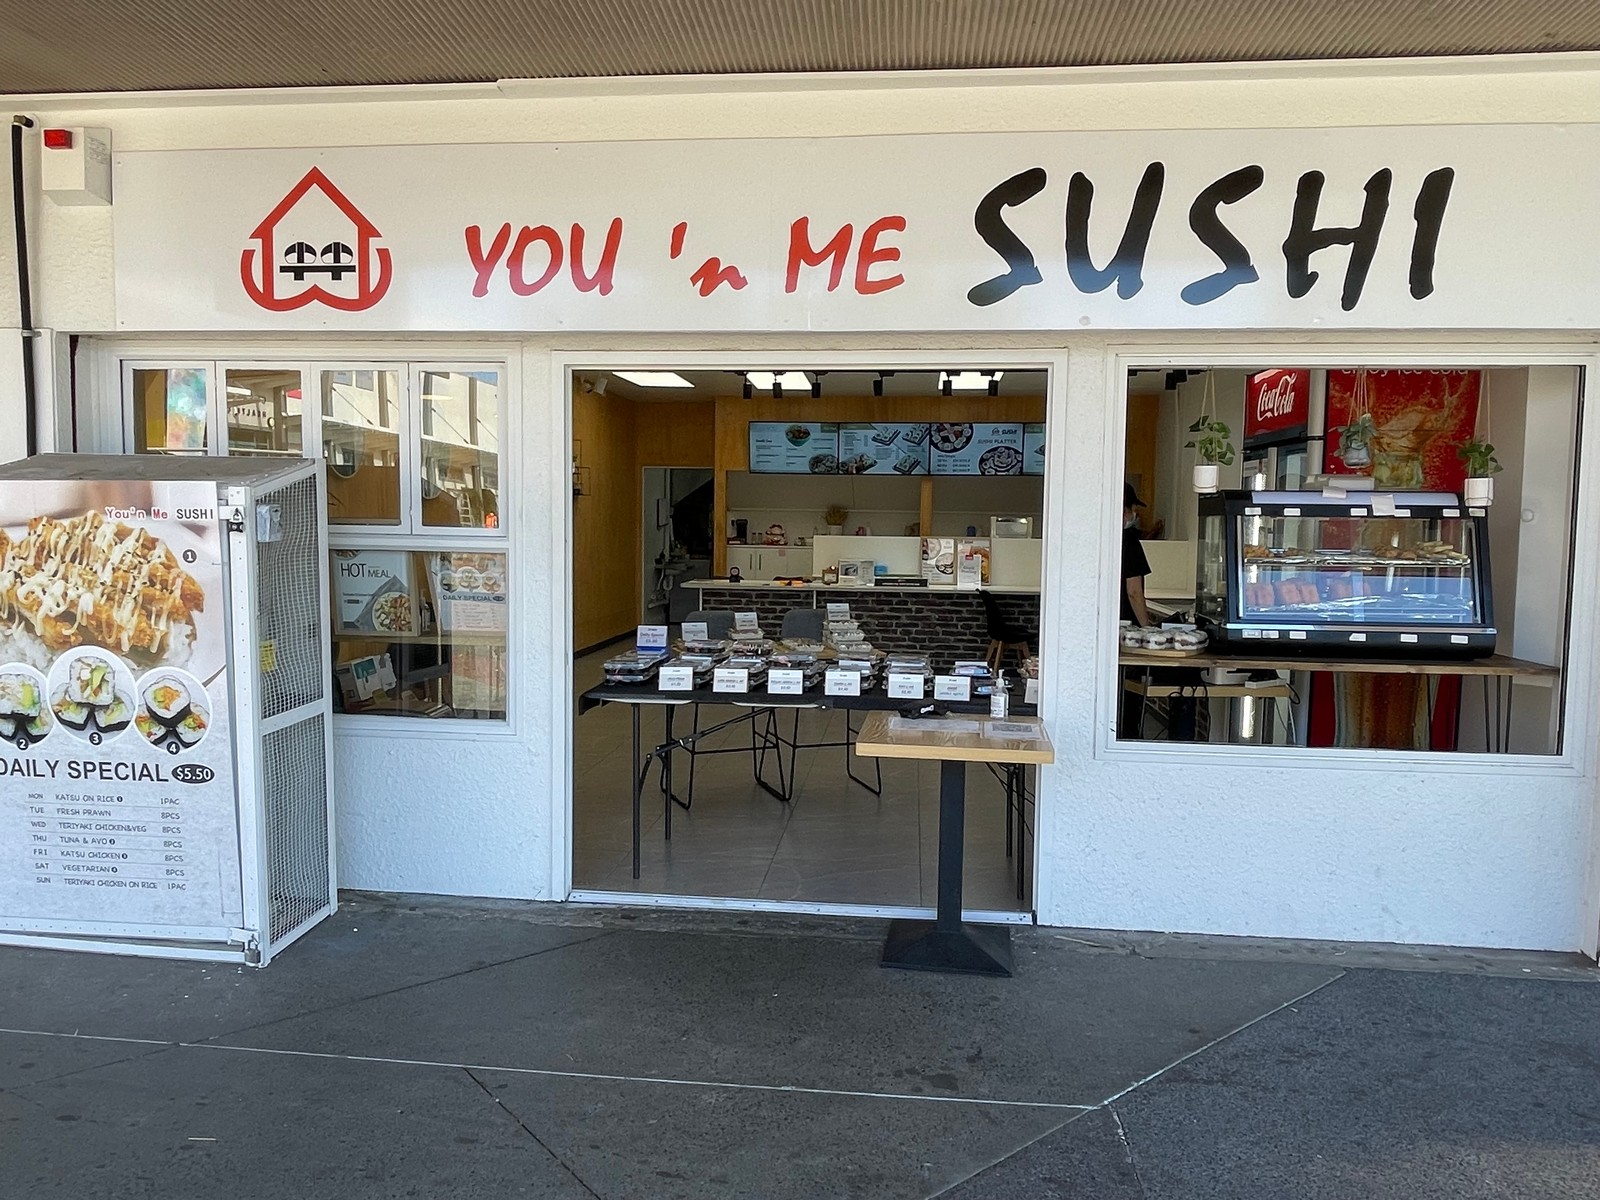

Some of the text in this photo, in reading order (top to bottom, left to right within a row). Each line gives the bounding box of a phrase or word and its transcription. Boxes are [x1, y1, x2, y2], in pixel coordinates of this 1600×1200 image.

[465, 217, 622, 297] YOU
[785, 216, 906, 294] ME
[967, 161, 1455, 311] SUSHI
[153, 508, 168, 519] Me
[176, 508, 214, 520] SUSHI
[340, 562, 391, 579] HOT MEAL
[67, 760, 169, 782] SPECIAL
[176, 767, 211, 781] $5.50
[59, 822, 92, 830] TERIYAKI
[162, 826, 181, 834] 8PCS
[62, 864, 110, 873] VEGETARIAN
[64, 878, 95, 886] TERIYAKI
[141, 881, 158, 889] RICE
